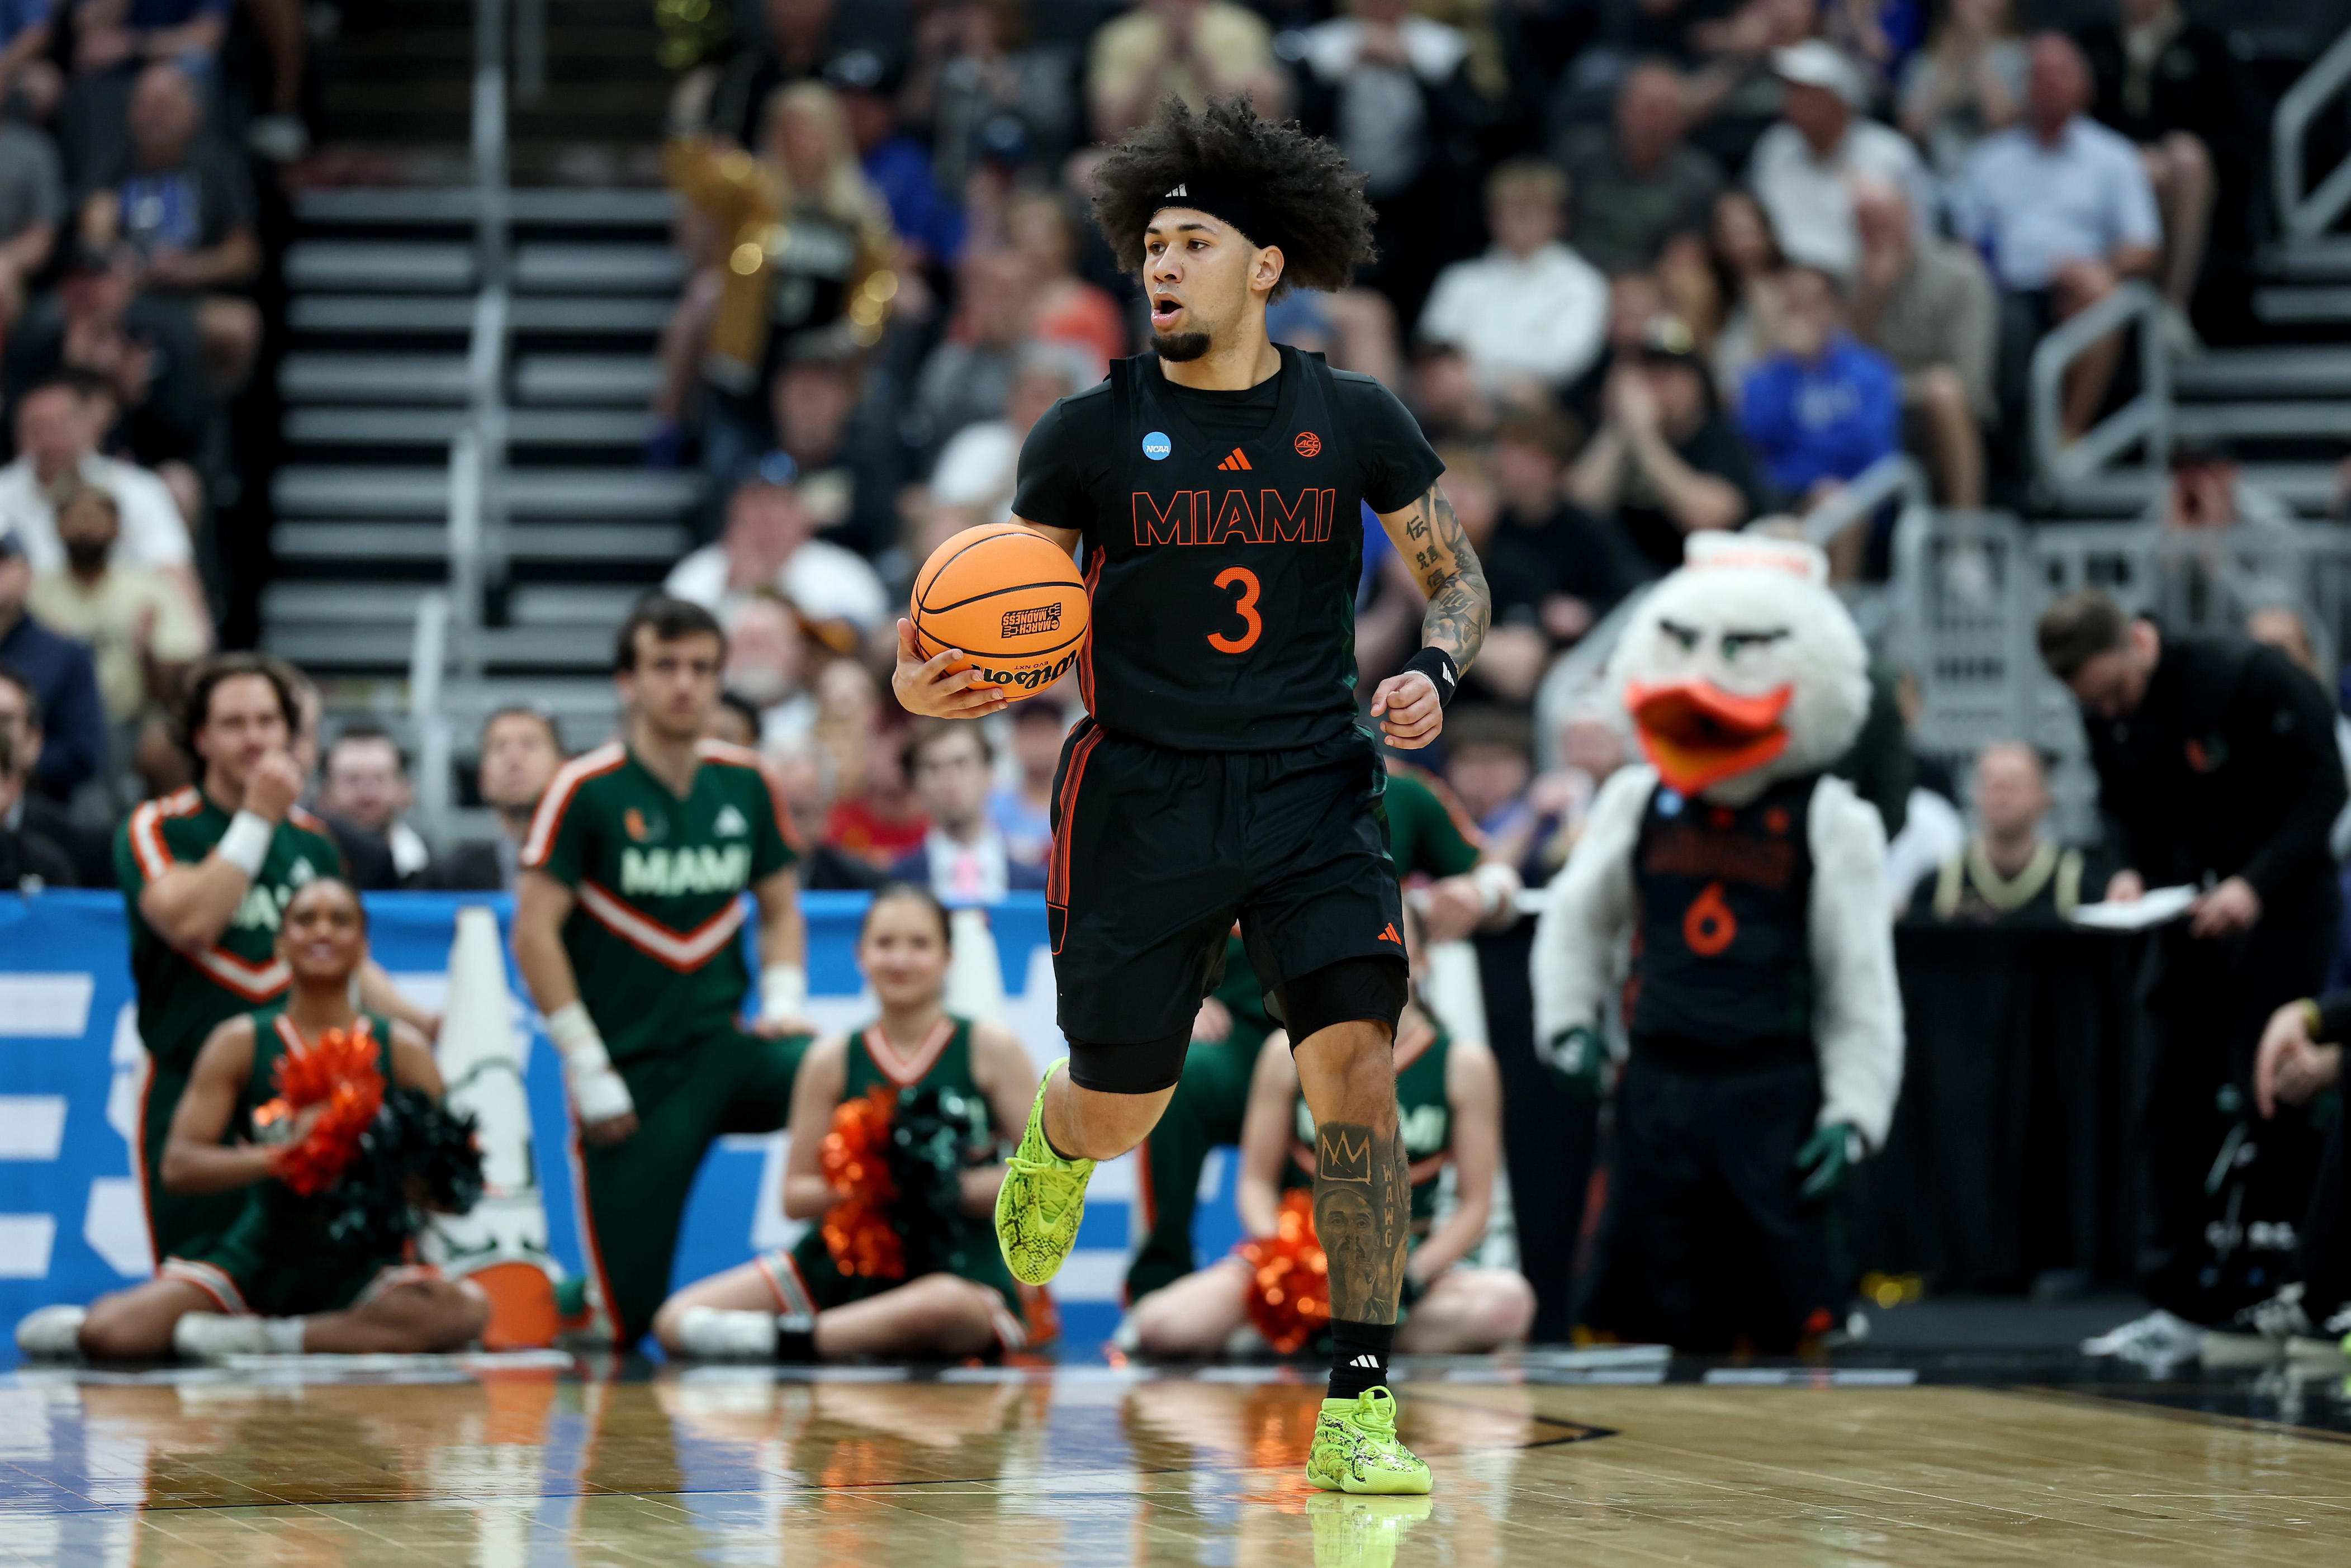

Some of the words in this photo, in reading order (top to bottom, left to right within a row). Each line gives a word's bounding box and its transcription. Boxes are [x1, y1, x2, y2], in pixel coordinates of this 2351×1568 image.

[1146, 445, 1170, 453] NCAA
[1132, 488, 1335, 546] MIAMI
[1002, 610, 1047, 626] MADNESS
[1019, 620, 1051, 634] MARCH
[1206, 566, 1263, 654] 3
[971, 650, 1077, 689] Wilson
[1682, 879, 1737, 958] 6
